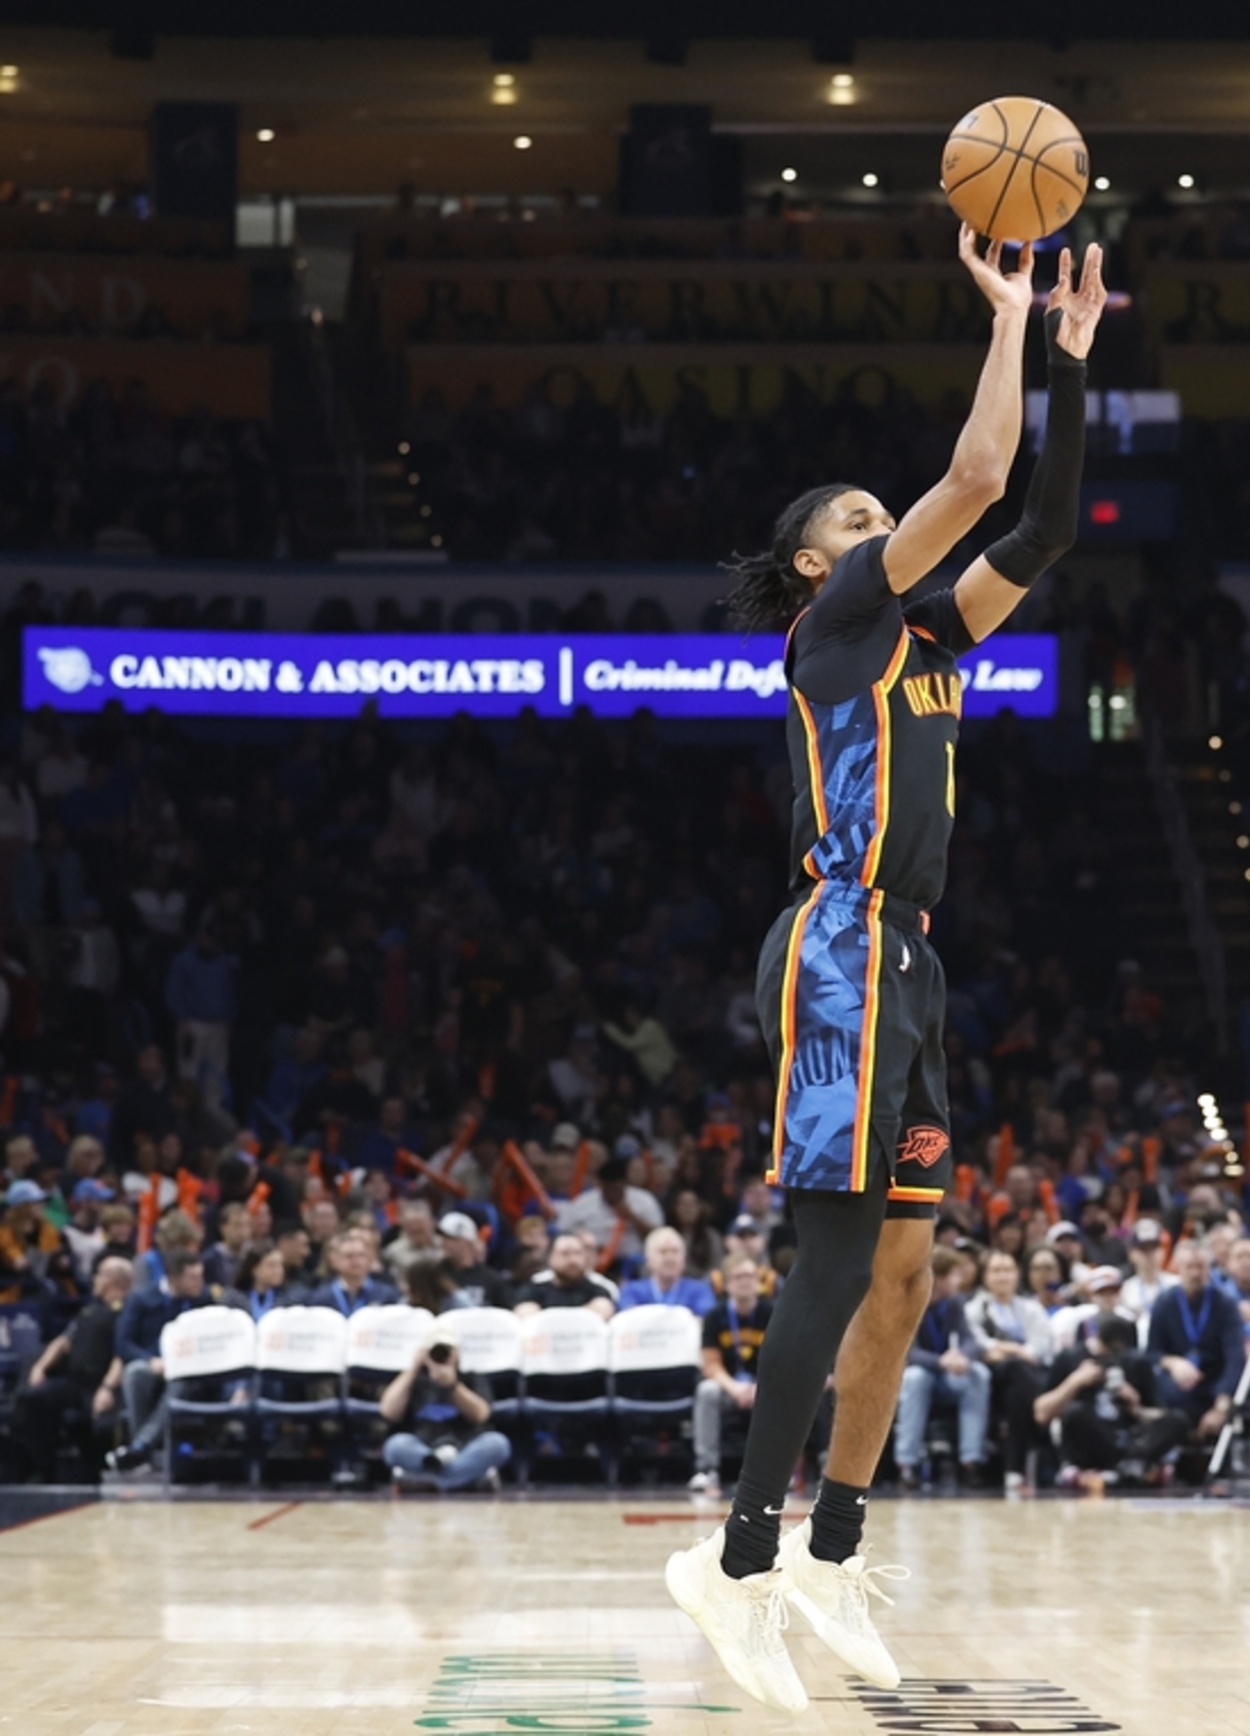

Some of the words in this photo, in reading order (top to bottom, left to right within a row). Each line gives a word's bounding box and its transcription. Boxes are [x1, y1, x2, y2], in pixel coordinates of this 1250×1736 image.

[109, 655, 272, 692] CANNON
[275, 661, 304, 693] &
[308, 659, 545, 694] ASSOCIATES
[583, 659, 723, 691] Criminal
[972, 660, 1042, 691] Law
